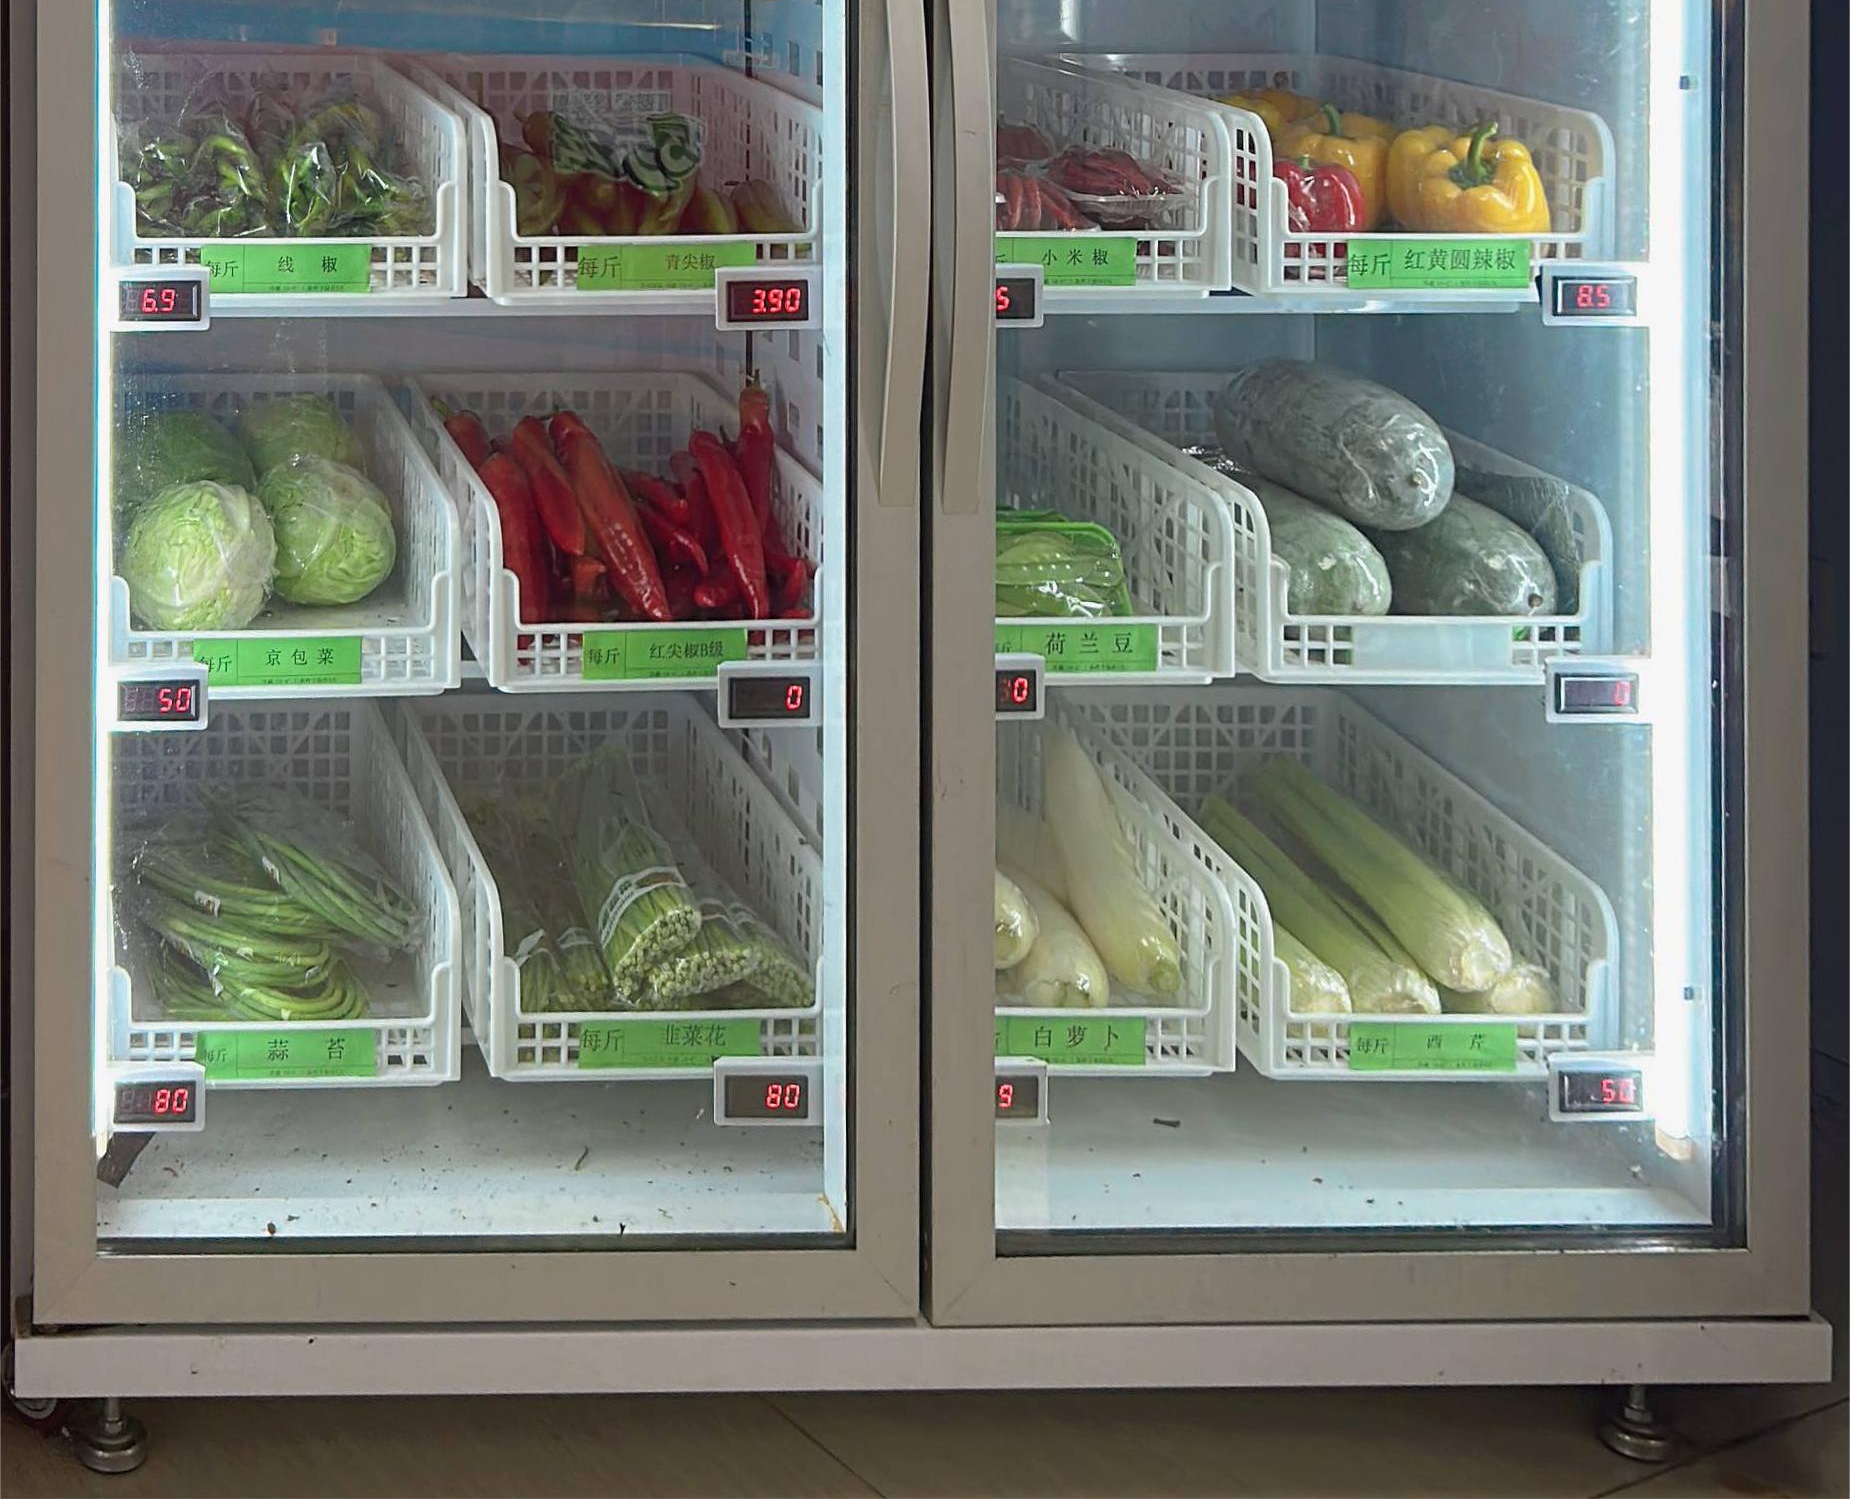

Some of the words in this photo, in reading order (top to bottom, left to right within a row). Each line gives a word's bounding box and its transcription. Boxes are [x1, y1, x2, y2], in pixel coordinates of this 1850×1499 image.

[578, 256, 621, 278] 每斤
[665, 253, 715, 271] 青尖椒
[1042, 248, 1108, 266] 小米椒
[1350, 254, 1391, 276] 每斤
[1404, 248, 1516, 271] 红黄圆辣椒
[1046, 631, 1133, 655] 荷兰豆
[265, 648, 334, 666] 京包菜
[588, 648, 620, 665] 每斤
[582, 1028, 623, 1051] 每斤
[664, 1024, 726, 1046] 韭菜花
[1035, 1025, 1119, 1051] 白萝卜
